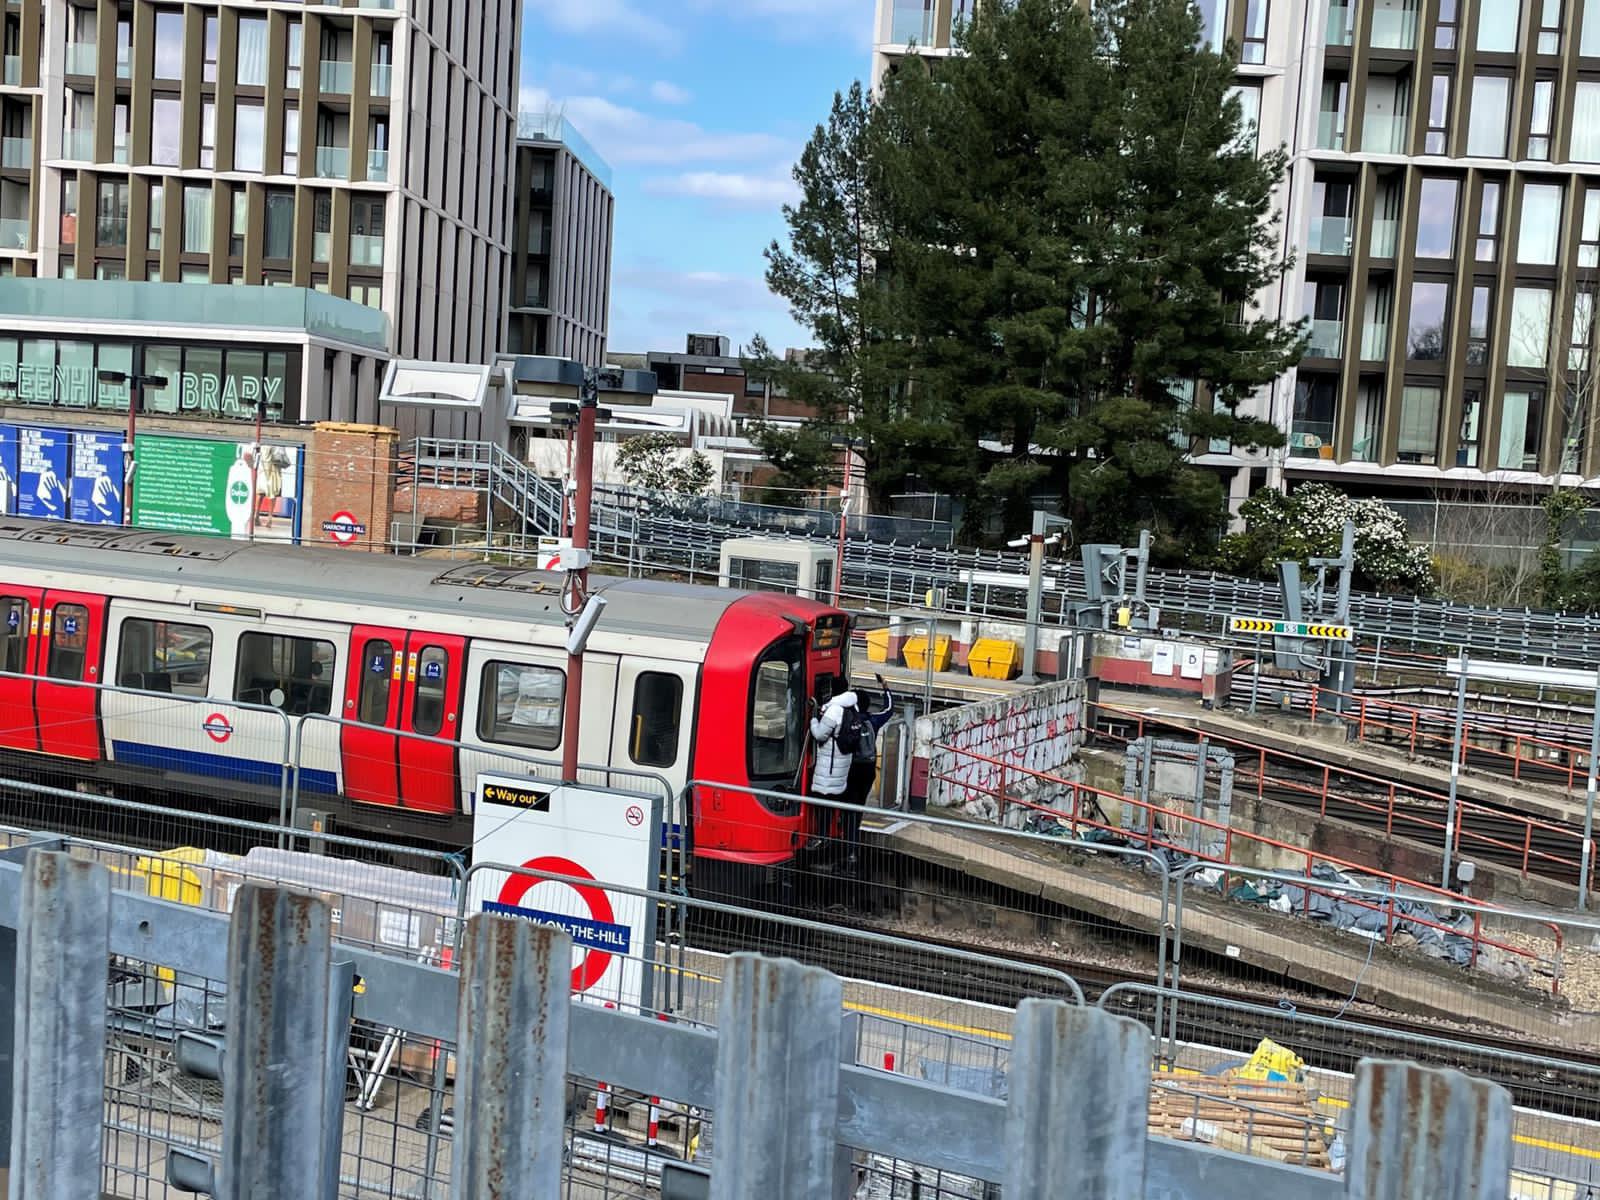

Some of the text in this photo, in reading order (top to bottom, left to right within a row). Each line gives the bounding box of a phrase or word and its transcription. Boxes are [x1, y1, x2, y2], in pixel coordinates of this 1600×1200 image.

[1189, 654, 1197, 664] D
[496, 787, 538, 805] Way out
